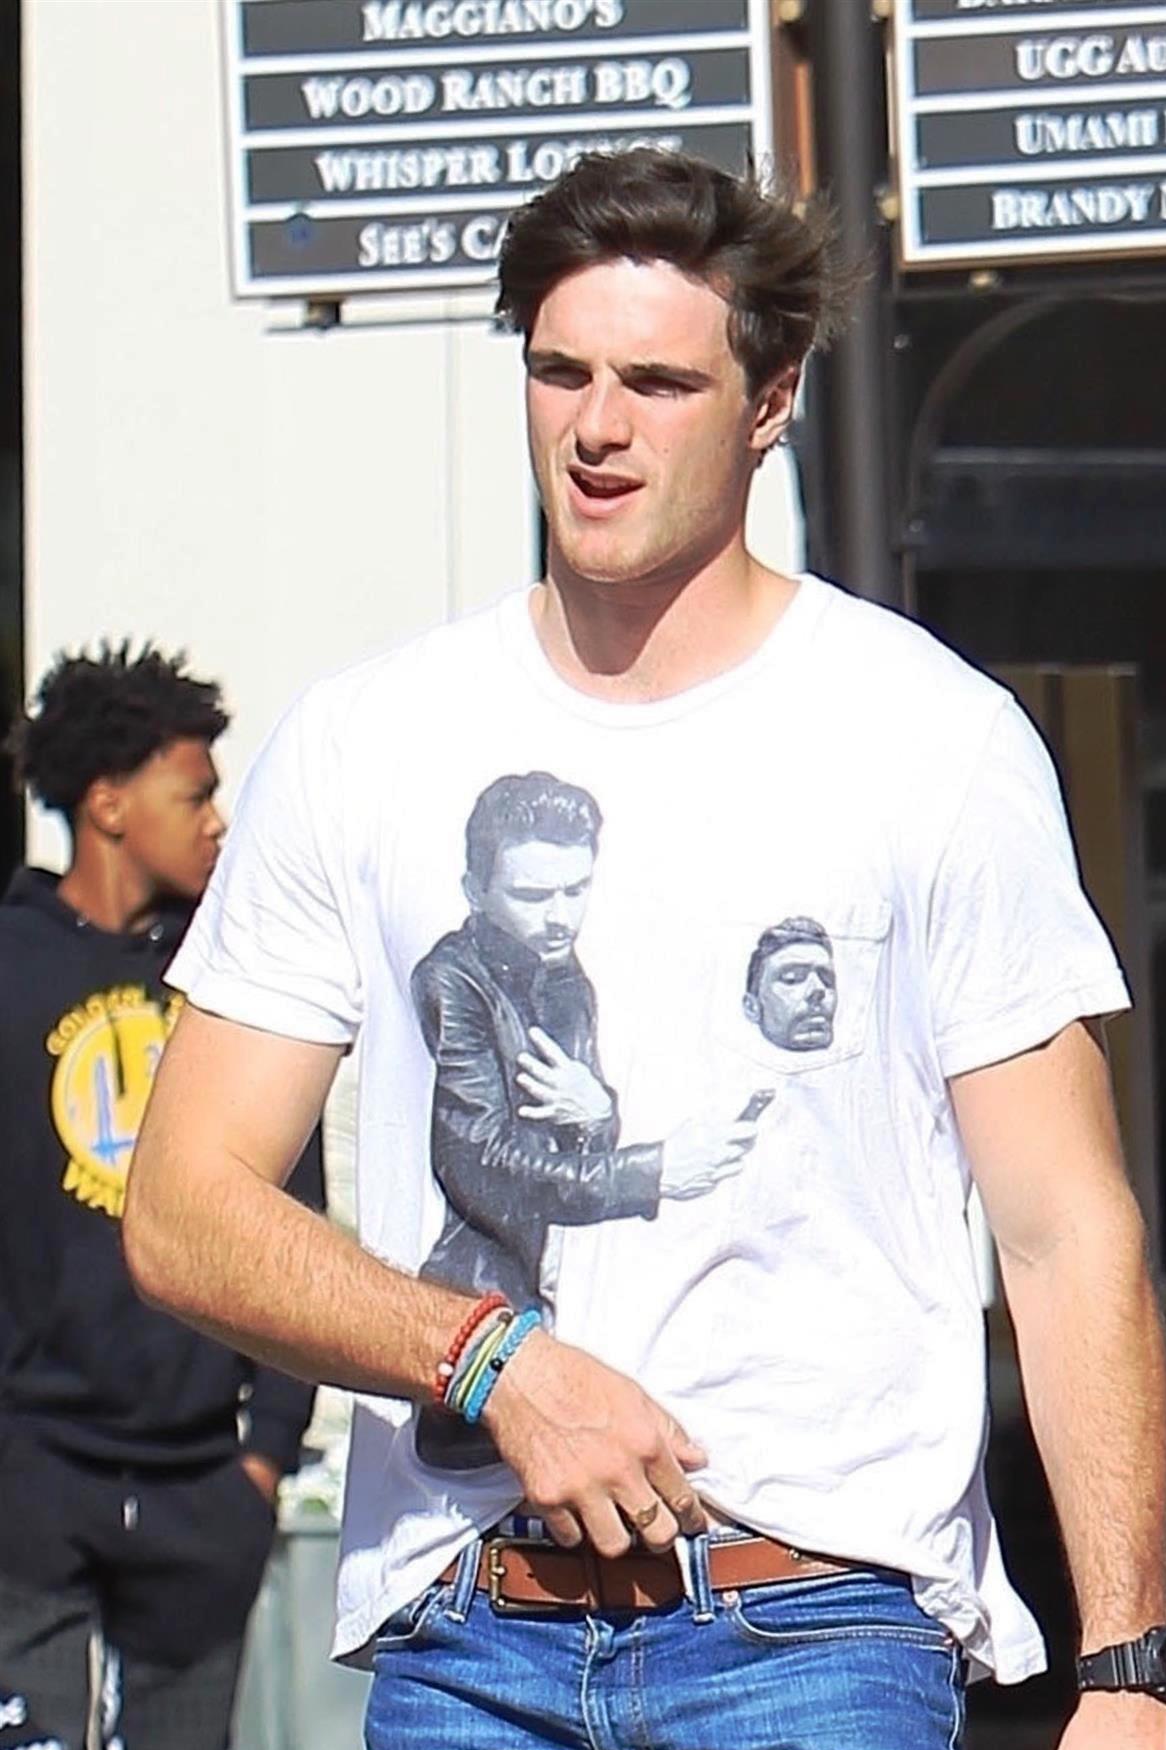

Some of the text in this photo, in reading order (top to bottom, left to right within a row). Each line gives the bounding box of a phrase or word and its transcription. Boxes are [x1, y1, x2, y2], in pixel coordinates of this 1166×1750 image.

[363, 0, 624, 42] MAGGIANO'S
[1015, 35, 1114, 80] UGG
[302, 57, 692, 119] WOOD RANCH BBQ
[1014, 109, 1159, 155] UMAMI
[315, 144, 501, 192] WHISPER
[990, 185, 1155, 230] BRANDY
[358, 217, 457, 267] SEE'S
